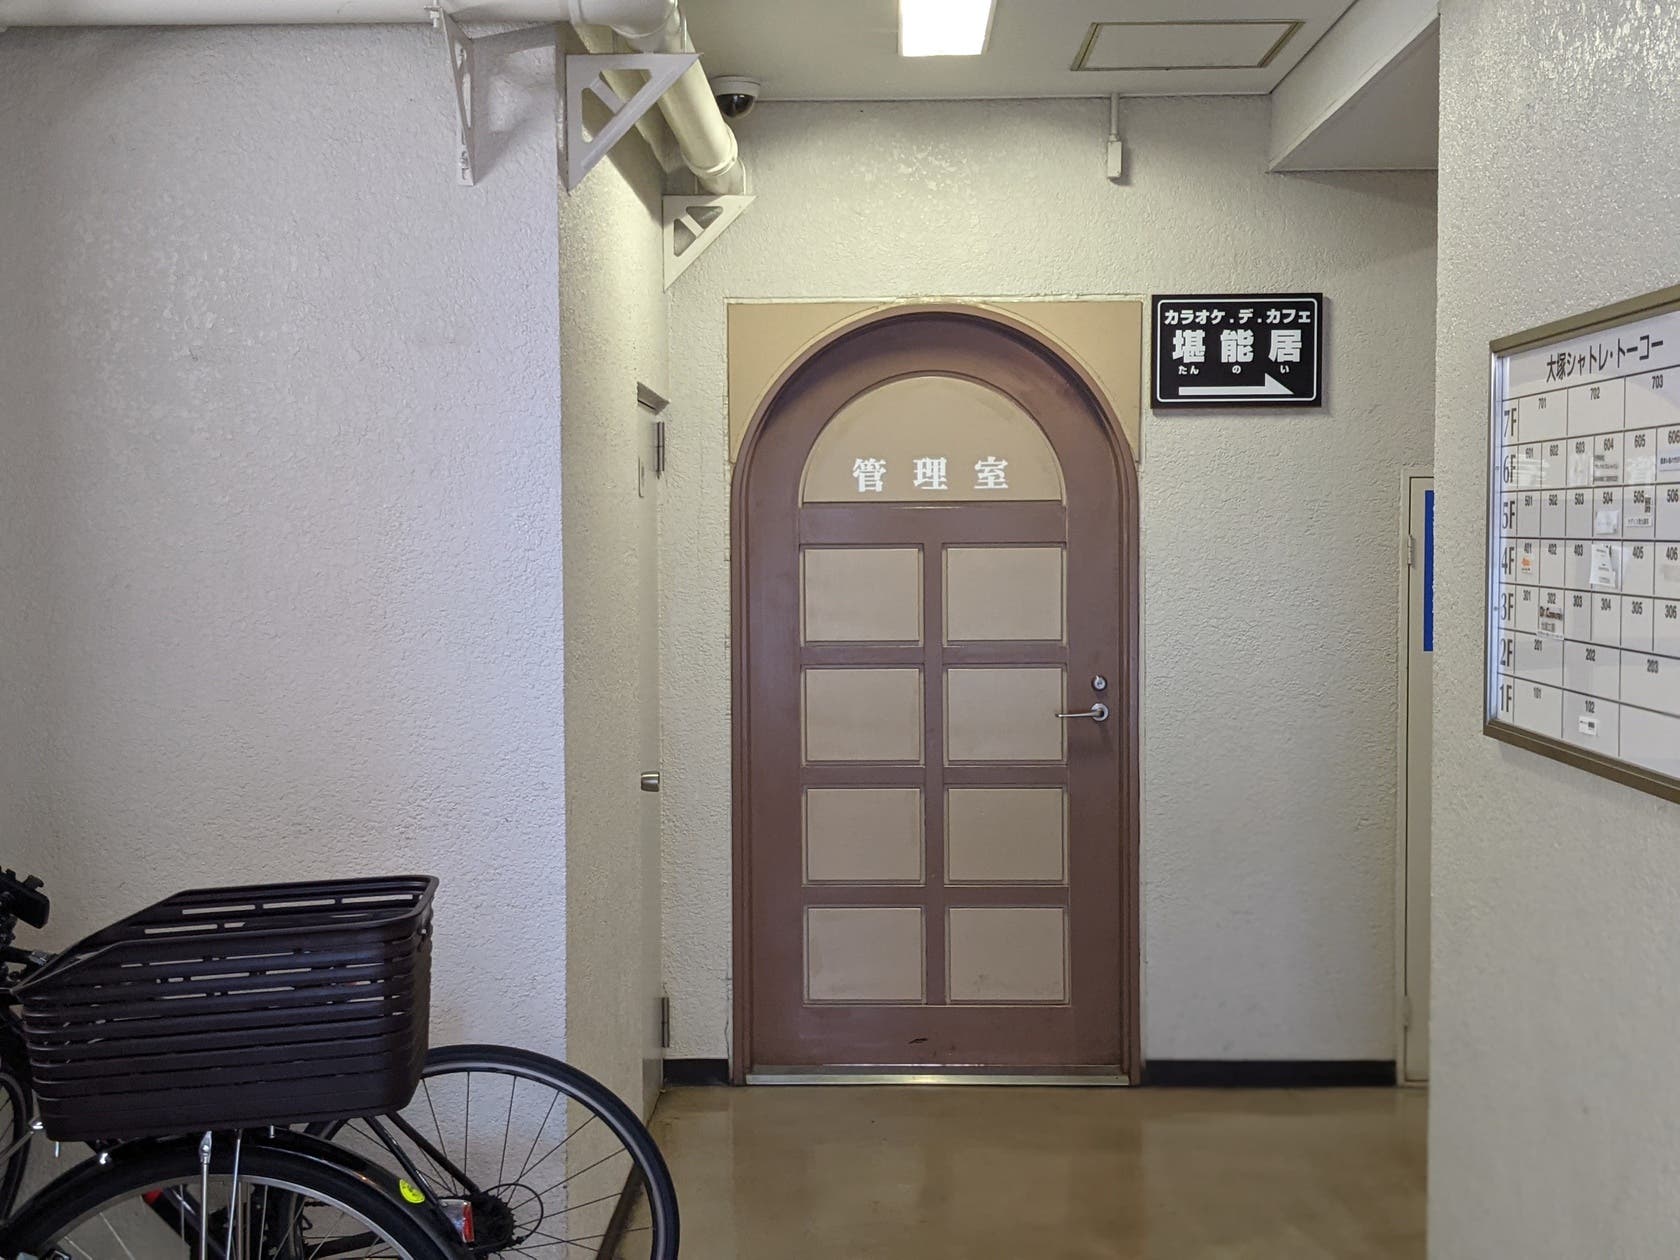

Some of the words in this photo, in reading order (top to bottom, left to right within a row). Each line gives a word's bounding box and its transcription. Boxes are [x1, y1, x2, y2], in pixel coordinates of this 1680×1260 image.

[1172, 329, 1303, 363] 堪能居
[1504, 408, 1517, 437] 7F
[1590, 386, 1600, 400] 702
[1652, 374, 1664, 390] 703
[852, 456, 1009, 493] 管理室
[1503, 454, 1516, 484] 6F
[1550, 444, 1559, 456] 602
[1576, 440, 1586, 454] 603
[1603, 437, 1614, 452] 604
[1634, 434, 1646, 448] 605
[1502, 500, 1516, 530] 5F
[1524, 496, 1533, 507] 501
[1548, 494, 1558, 506] 502
[1574, 492, 1584, 506] 503
[1602, 491, 1614, 505] 504
[1633, 490, 1645, 504] 505
[1666, 488, 1679, 503] 506
[1501, 546, 1515, 575] 4F
[1548, 543, 1558, 556] 402
[1574, 544, 1584, 557] 403
[1632, 546, 1644, 560] 405
[1666, 546, 1678, 561] 406
[1500, 592, 1514, 620] 3F
[1600, 597, 1612, 612] 304
[1632, 600, 1643, 616] 305
[1664, 604, 1678, 620] 306
[1500, 638, 1513, 667] 2F
[1585, 648, 1596, 662] 202
[1646, 658, 1659, 674] 203
[1500, 684, 1512, 713] 1F
[1584, 700, 1595, 714] 102
